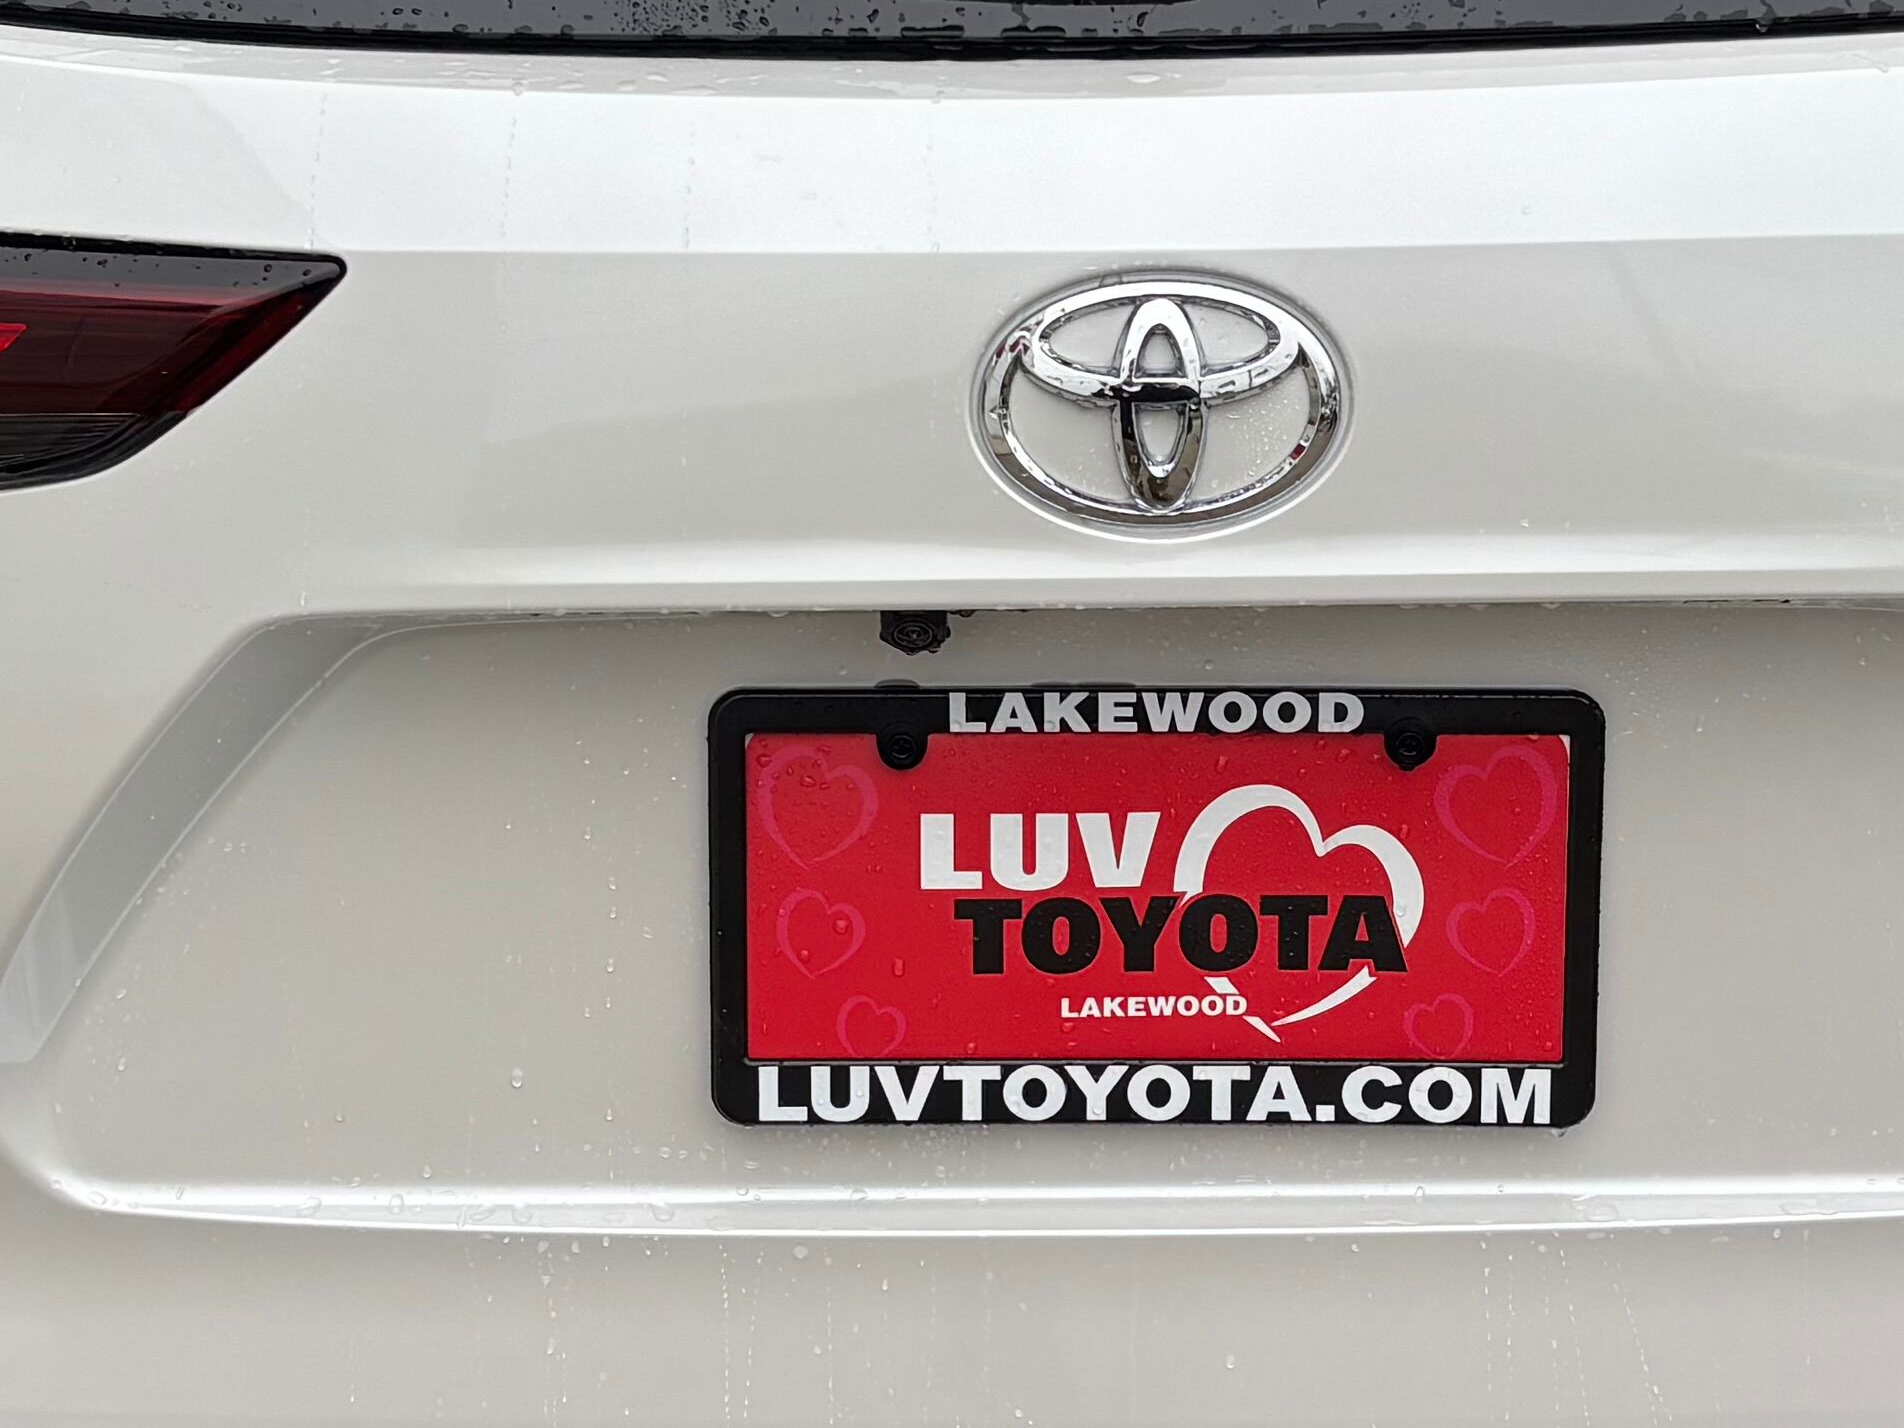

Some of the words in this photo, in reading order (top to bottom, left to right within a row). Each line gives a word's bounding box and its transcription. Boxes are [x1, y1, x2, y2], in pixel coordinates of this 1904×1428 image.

[949, 691, 1365, 734] LAKEWOOD
[919, 812, 1160, 890] LUV
[954, 894, 1408, 975] TOYOTA
[1060, 995, 1247, 1018] LAKEWOOD
[756, 1065, 1552, 1124] LUVTOYOTA.COM
